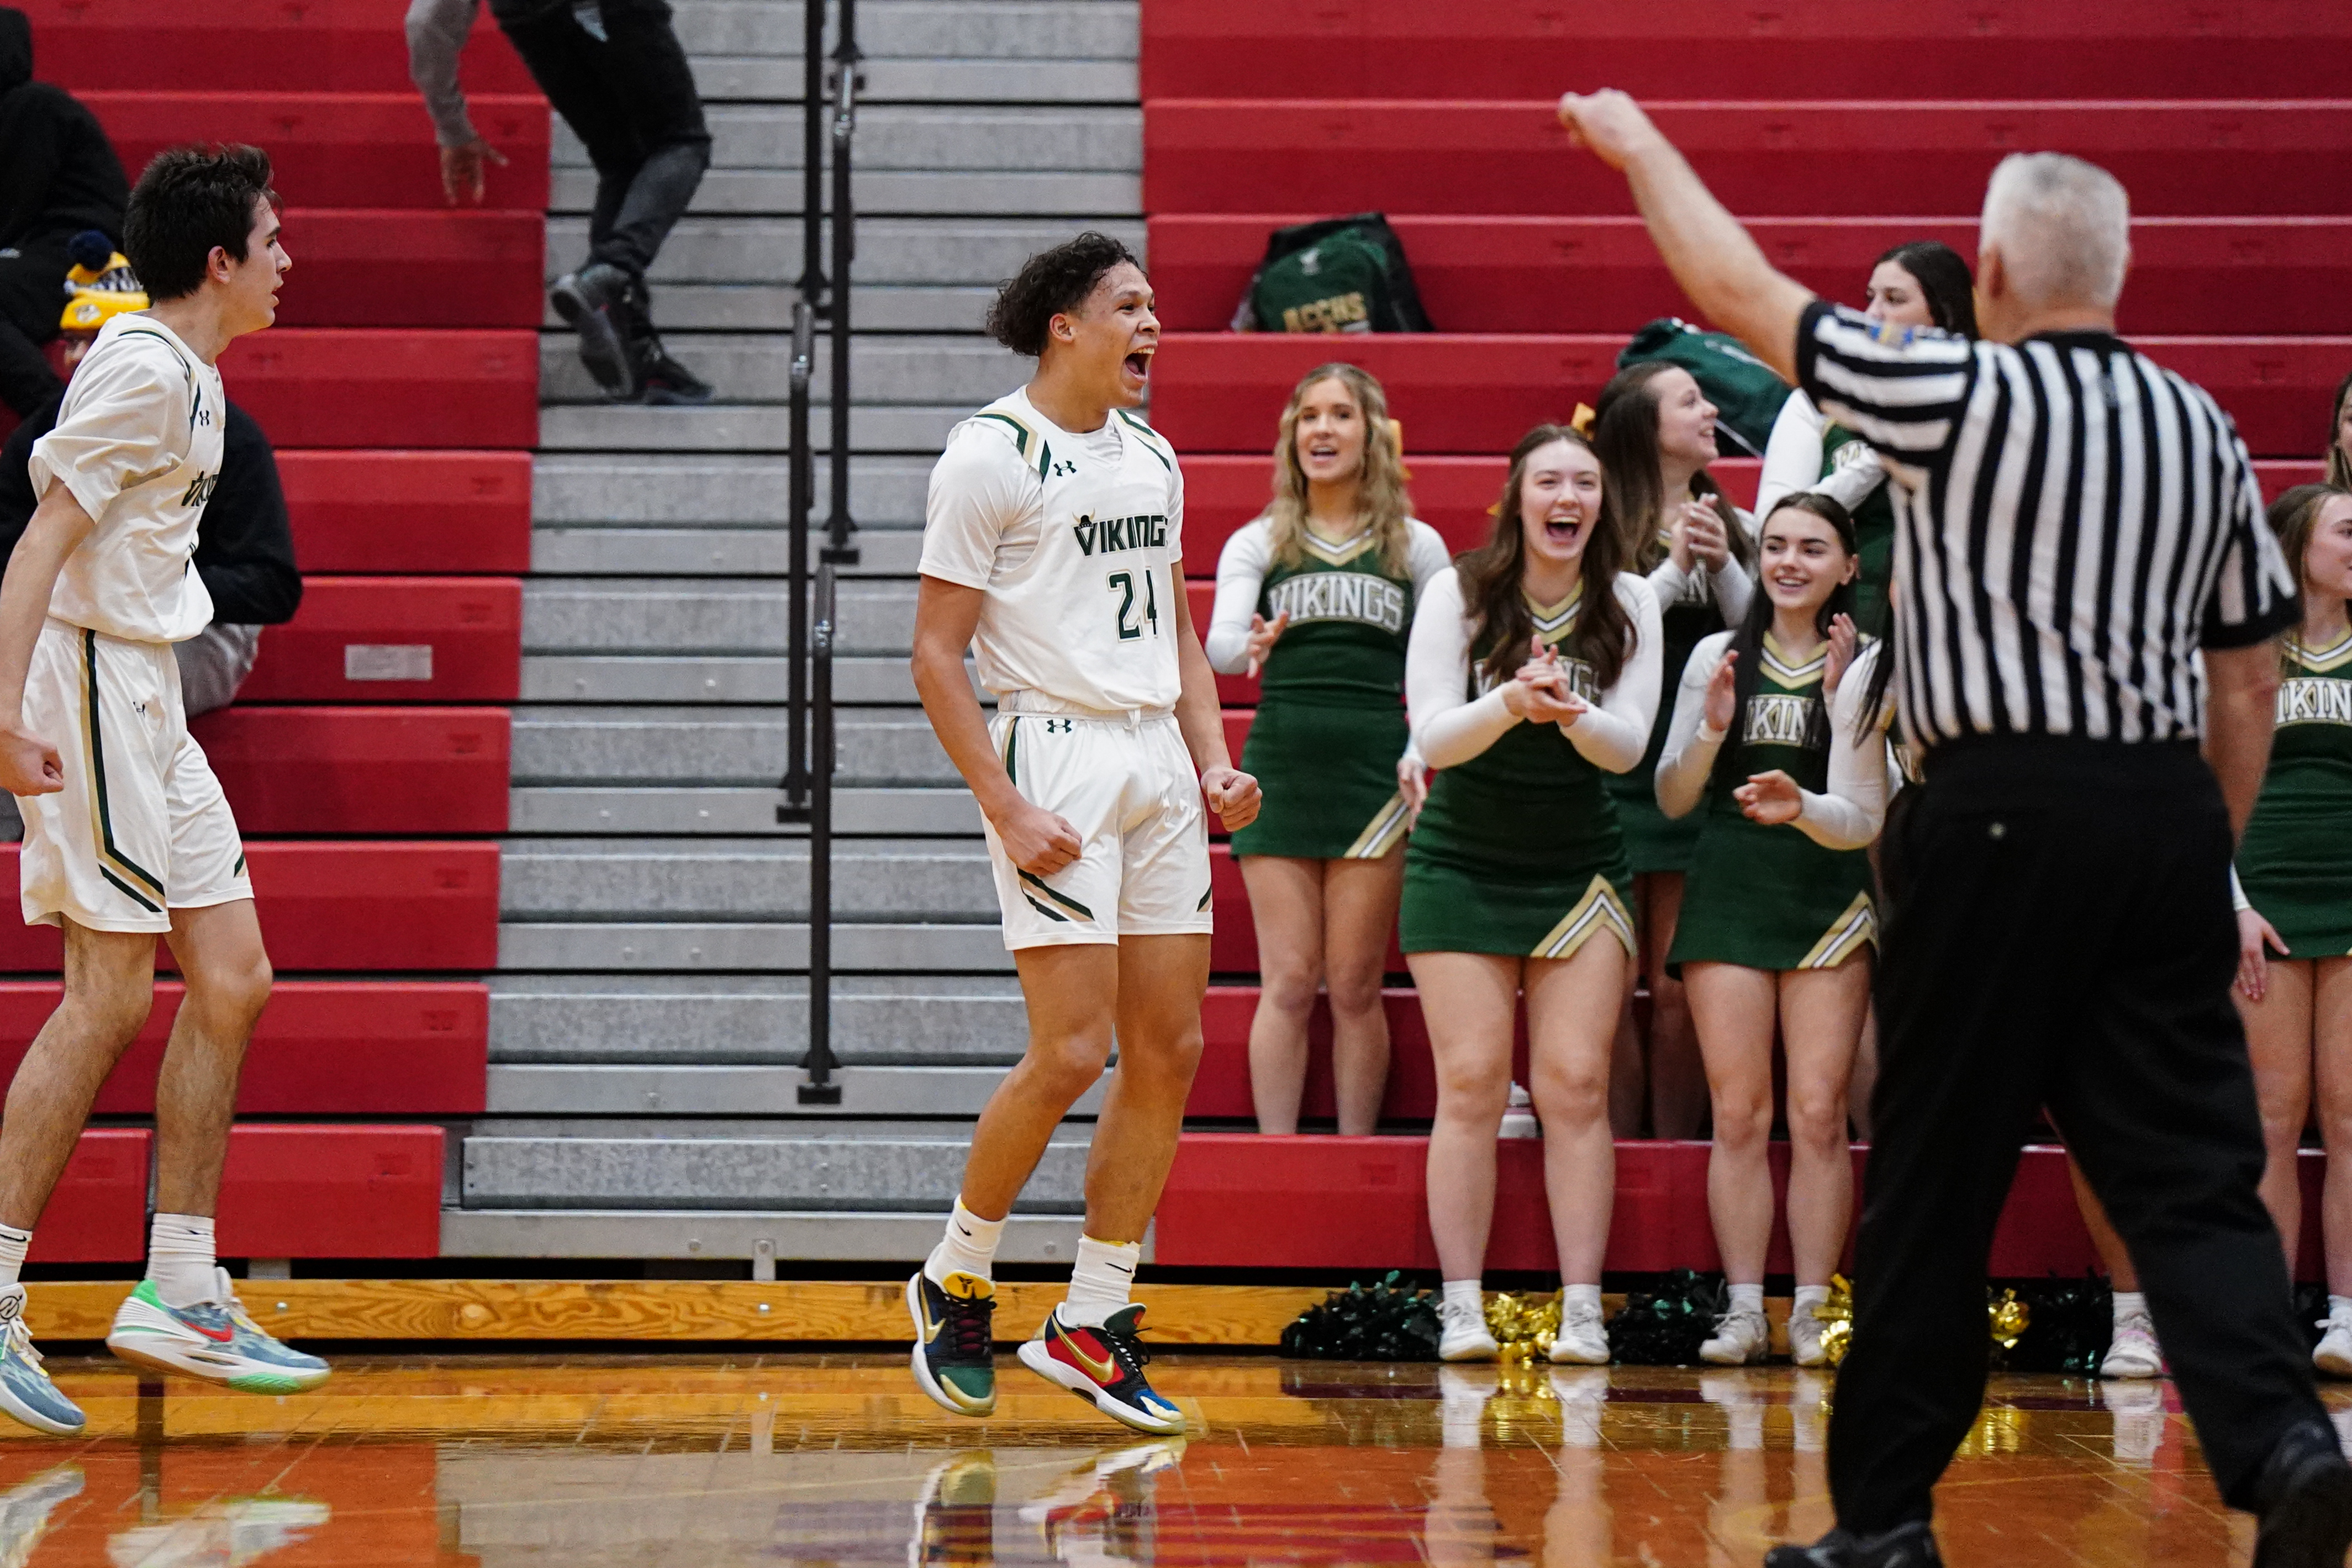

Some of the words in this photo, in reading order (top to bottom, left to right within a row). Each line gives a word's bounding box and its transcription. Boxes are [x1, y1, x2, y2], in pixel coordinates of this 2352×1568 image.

[1072, 514, 1169, 557] VIKING
[1107, 567, 1158, 642] 24
[1269, 576, 1404, 632] VIKINGS
[2275, 680, 2352, 723] IKIN
